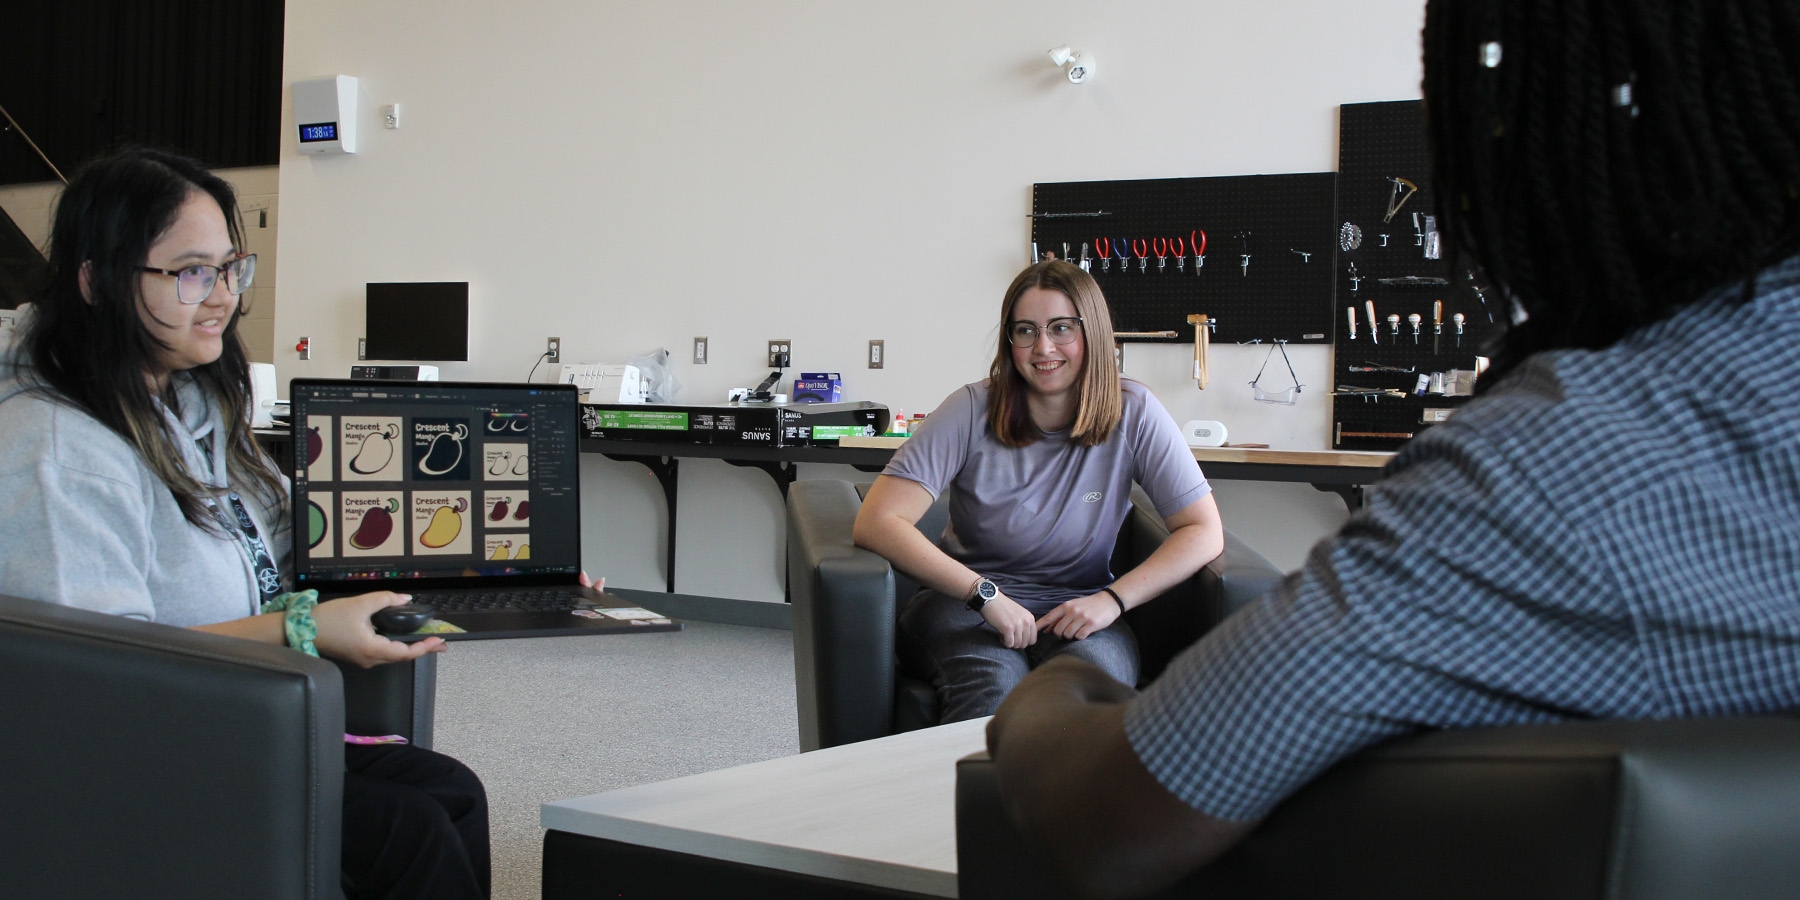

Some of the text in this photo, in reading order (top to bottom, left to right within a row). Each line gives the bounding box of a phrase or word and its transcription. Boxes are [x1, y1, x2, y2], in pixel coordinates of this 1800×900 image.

[307, 127, 323, 138] 1:38
[345, 422, 380, 431] Crescent
[415, 422, 450, 432] Crescent
[345, 433, 365, 441] Mango
[415, 433, 435, 442] Mango
[742, 431, 771, 440] SANUS
[345, 496, 381, 505] Crescent
[416, 496, 450, 505] Crescent
[345, 508, 365, 516] Mango
[416, 507, 435, 516] Mango
